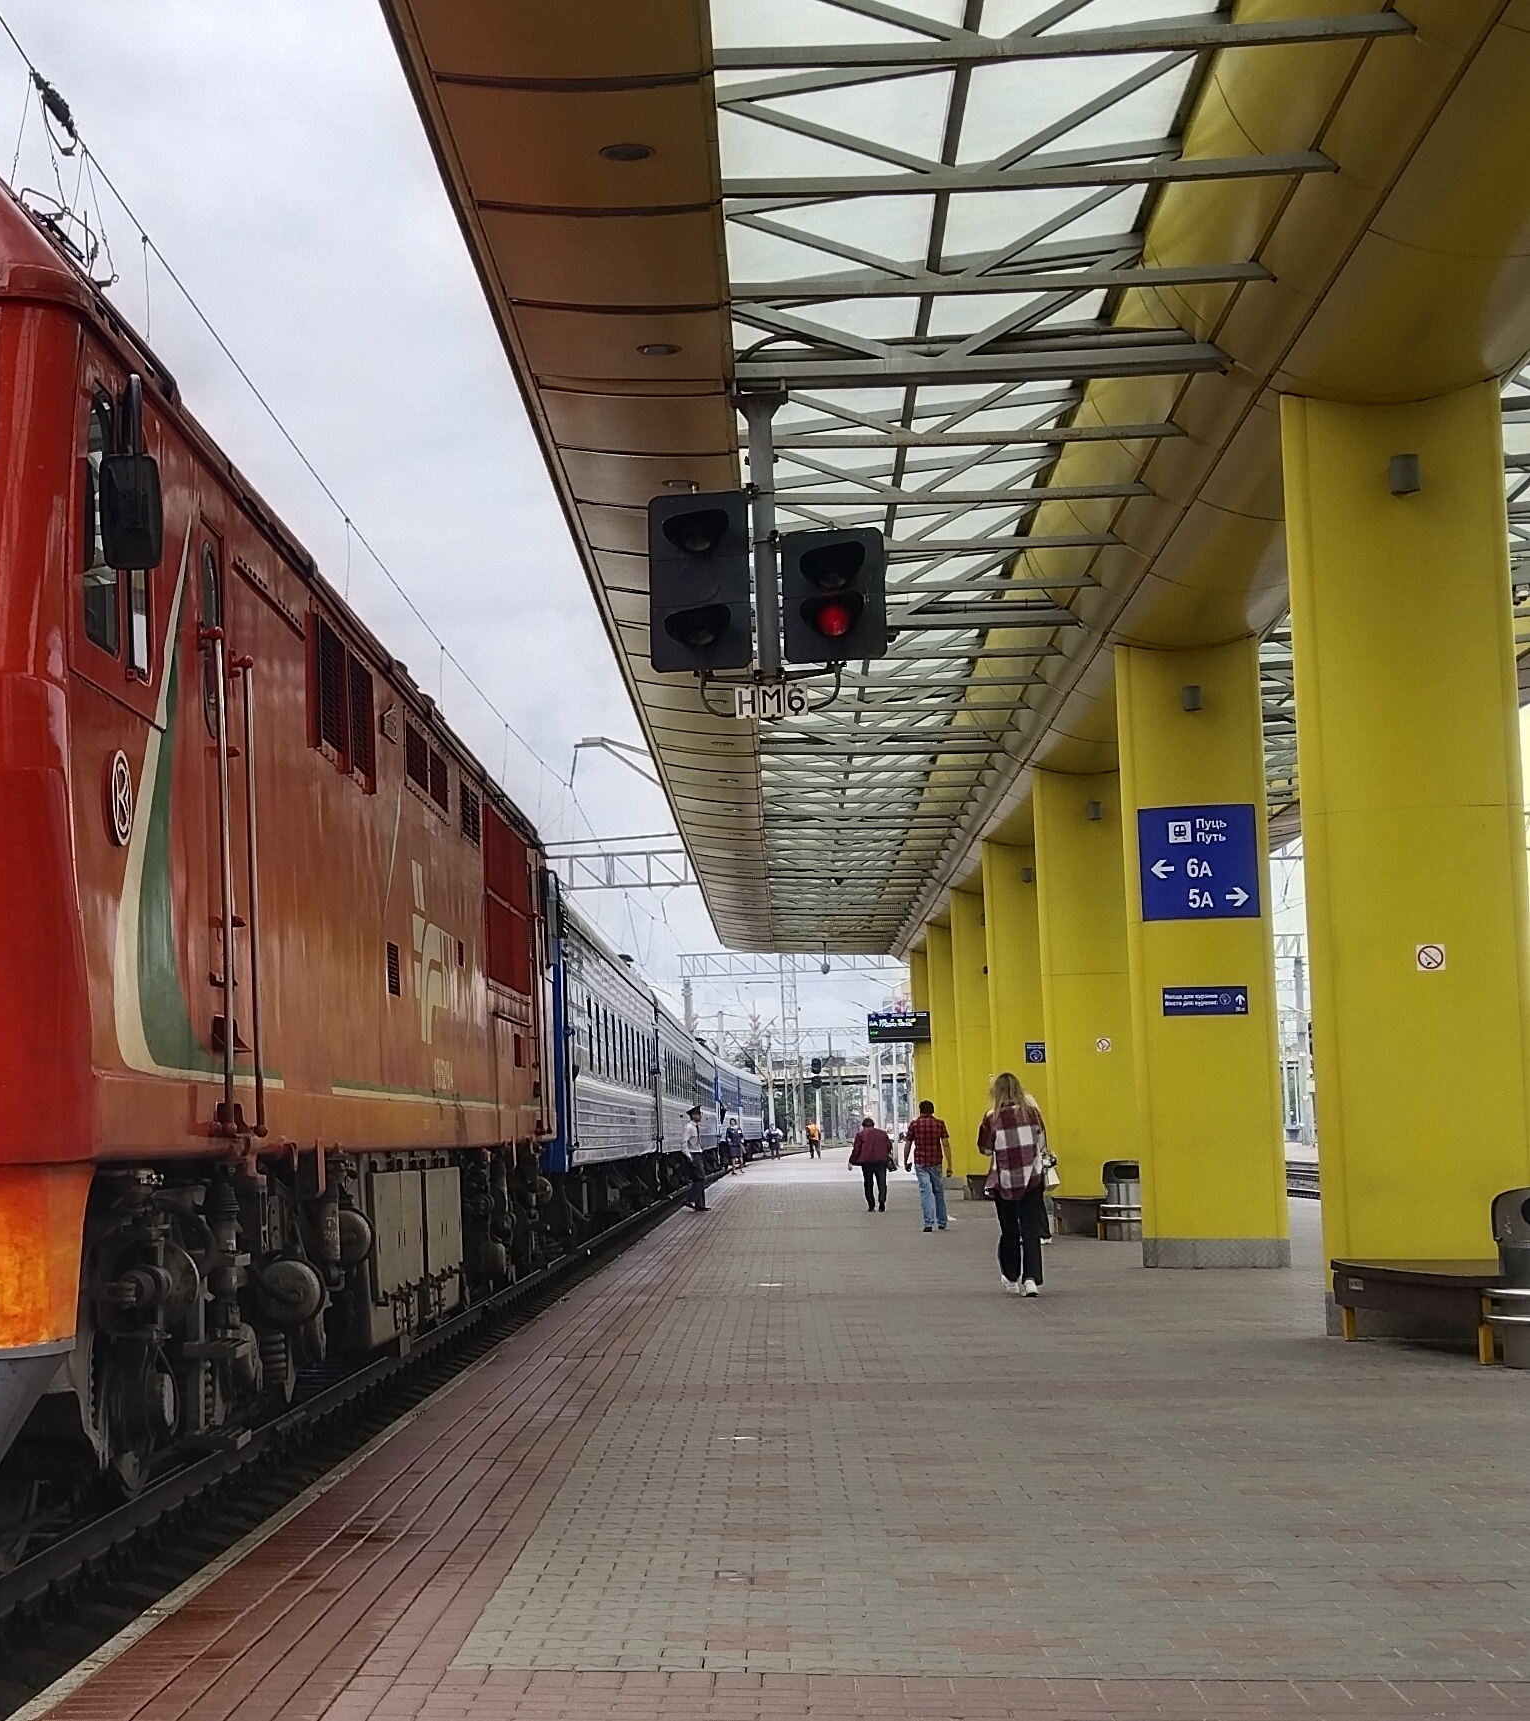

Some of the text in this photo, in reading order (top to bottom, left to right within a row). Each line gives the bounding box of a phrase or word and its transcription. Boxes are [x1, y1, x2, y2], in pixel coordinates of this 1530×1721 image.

[1195, 817, 1228, 831] Пуць
[1196, 831, 1227, 845] Путь
[1186, 858, 1213, 878] 6А
[1188, 888, 1214, 908] 5А
